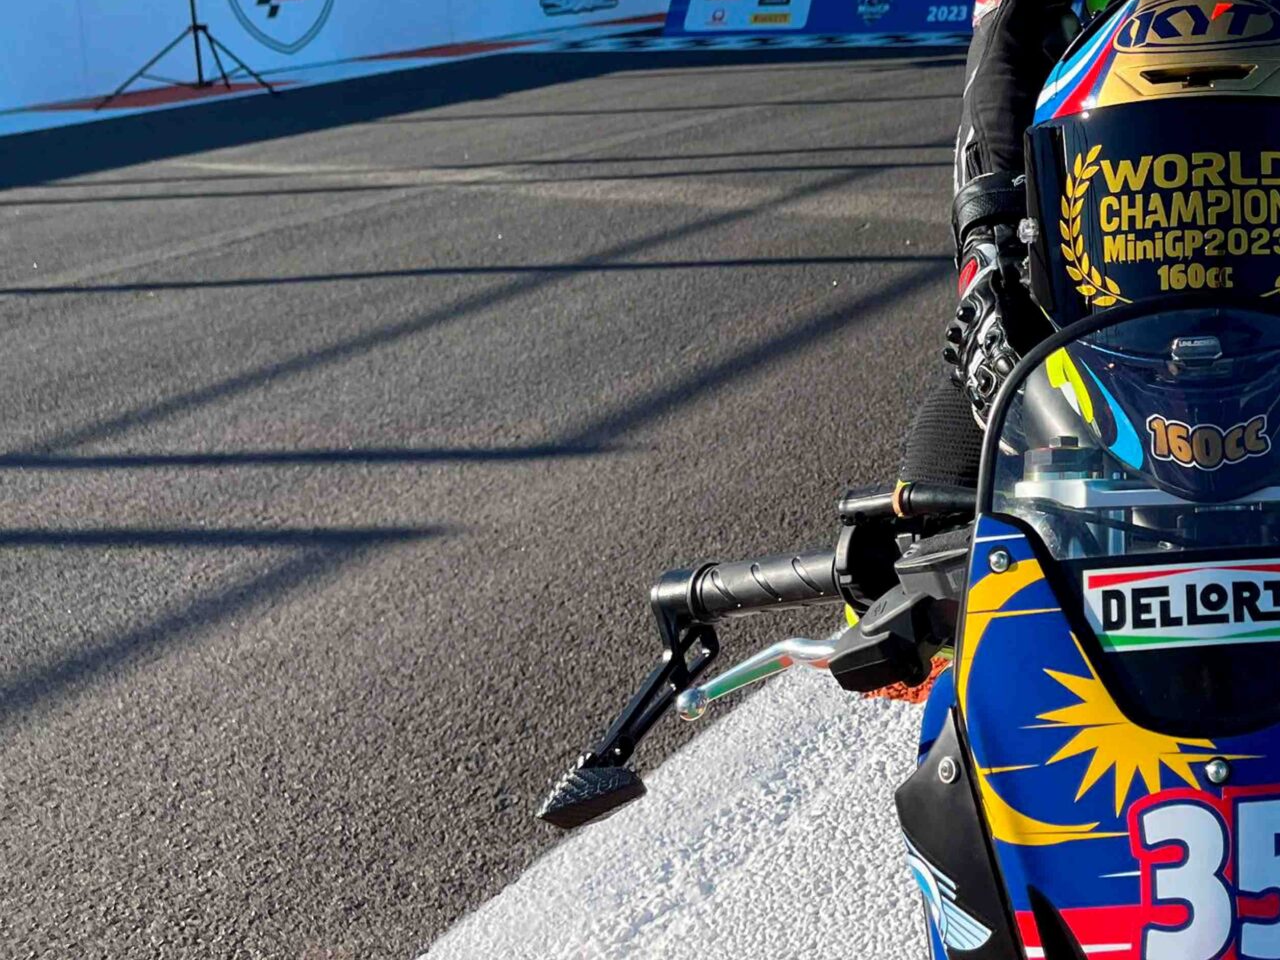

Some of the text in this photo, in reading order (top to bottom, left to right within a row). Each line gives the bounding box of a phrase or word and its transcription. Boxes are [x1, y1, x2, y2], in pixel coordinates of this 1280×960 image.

[926, 5, 968, 22] 2023
[1133, 3, 1275, 48] KYT
[1156, 262, 1234, 291] 160cc
[1148, 415, 1270, 470] 160cc
